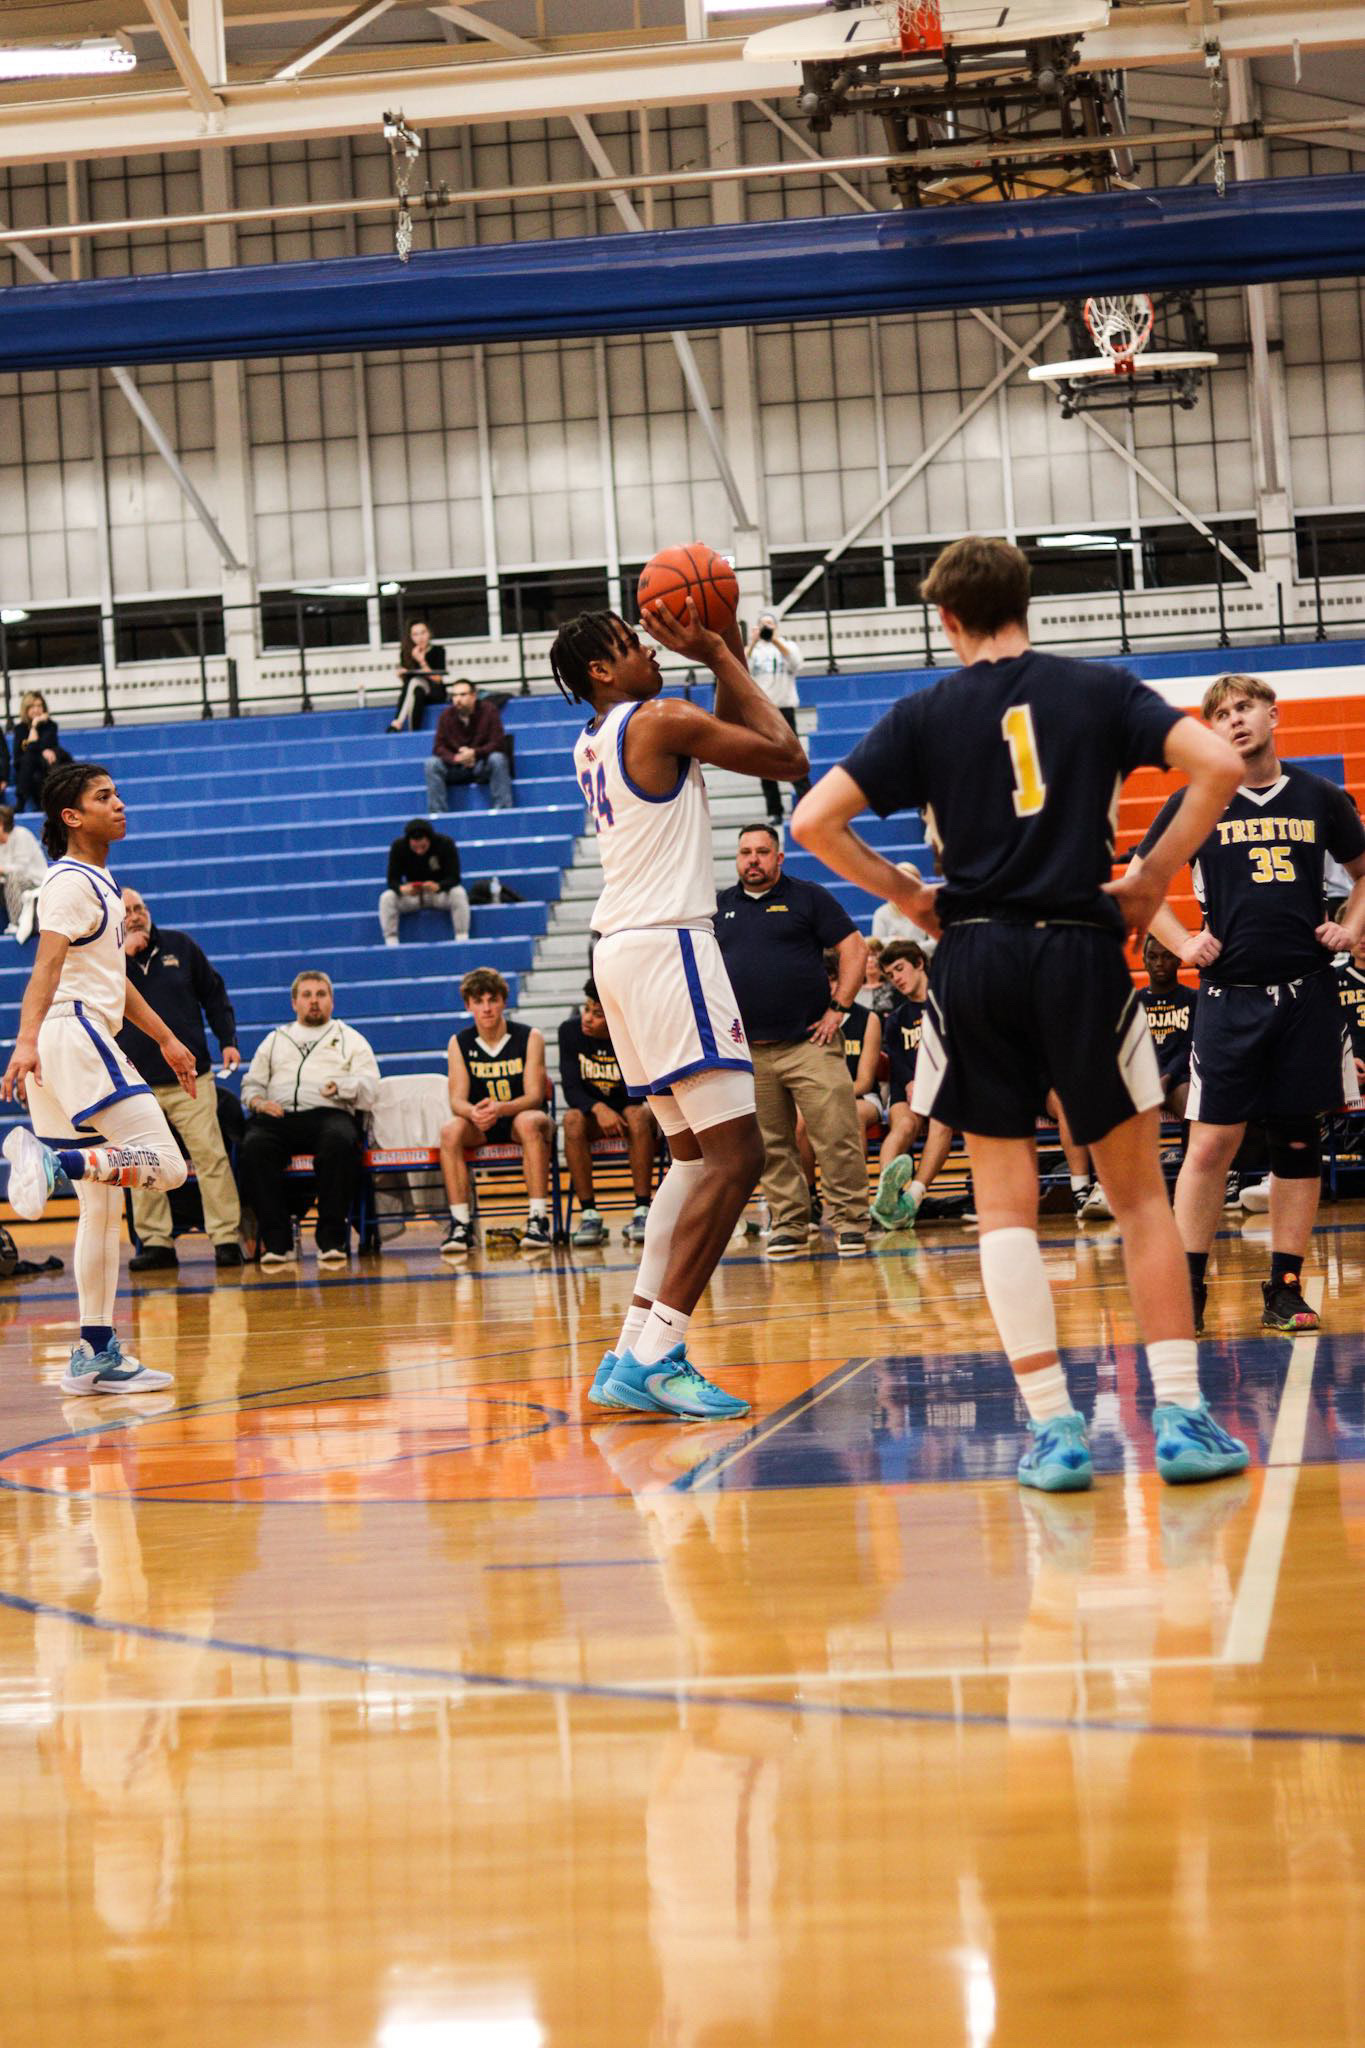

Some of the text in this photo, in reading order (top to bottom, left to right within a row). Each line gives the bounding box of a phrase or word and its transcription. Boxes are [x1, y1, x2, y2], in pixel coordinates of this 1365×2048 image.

[1002, 703, 1046, 818] 1
[1217, 817, 1316, 845] TRENTON
[1249, 846, 1296, 884] 35
[1147, 1005, 1190, 1031] OJANS
[469, 1057, 523, 1079] TRENTON
[578, 1053, 622, 1081] TROJAN
[486, 1079, 512, 1101] 10
